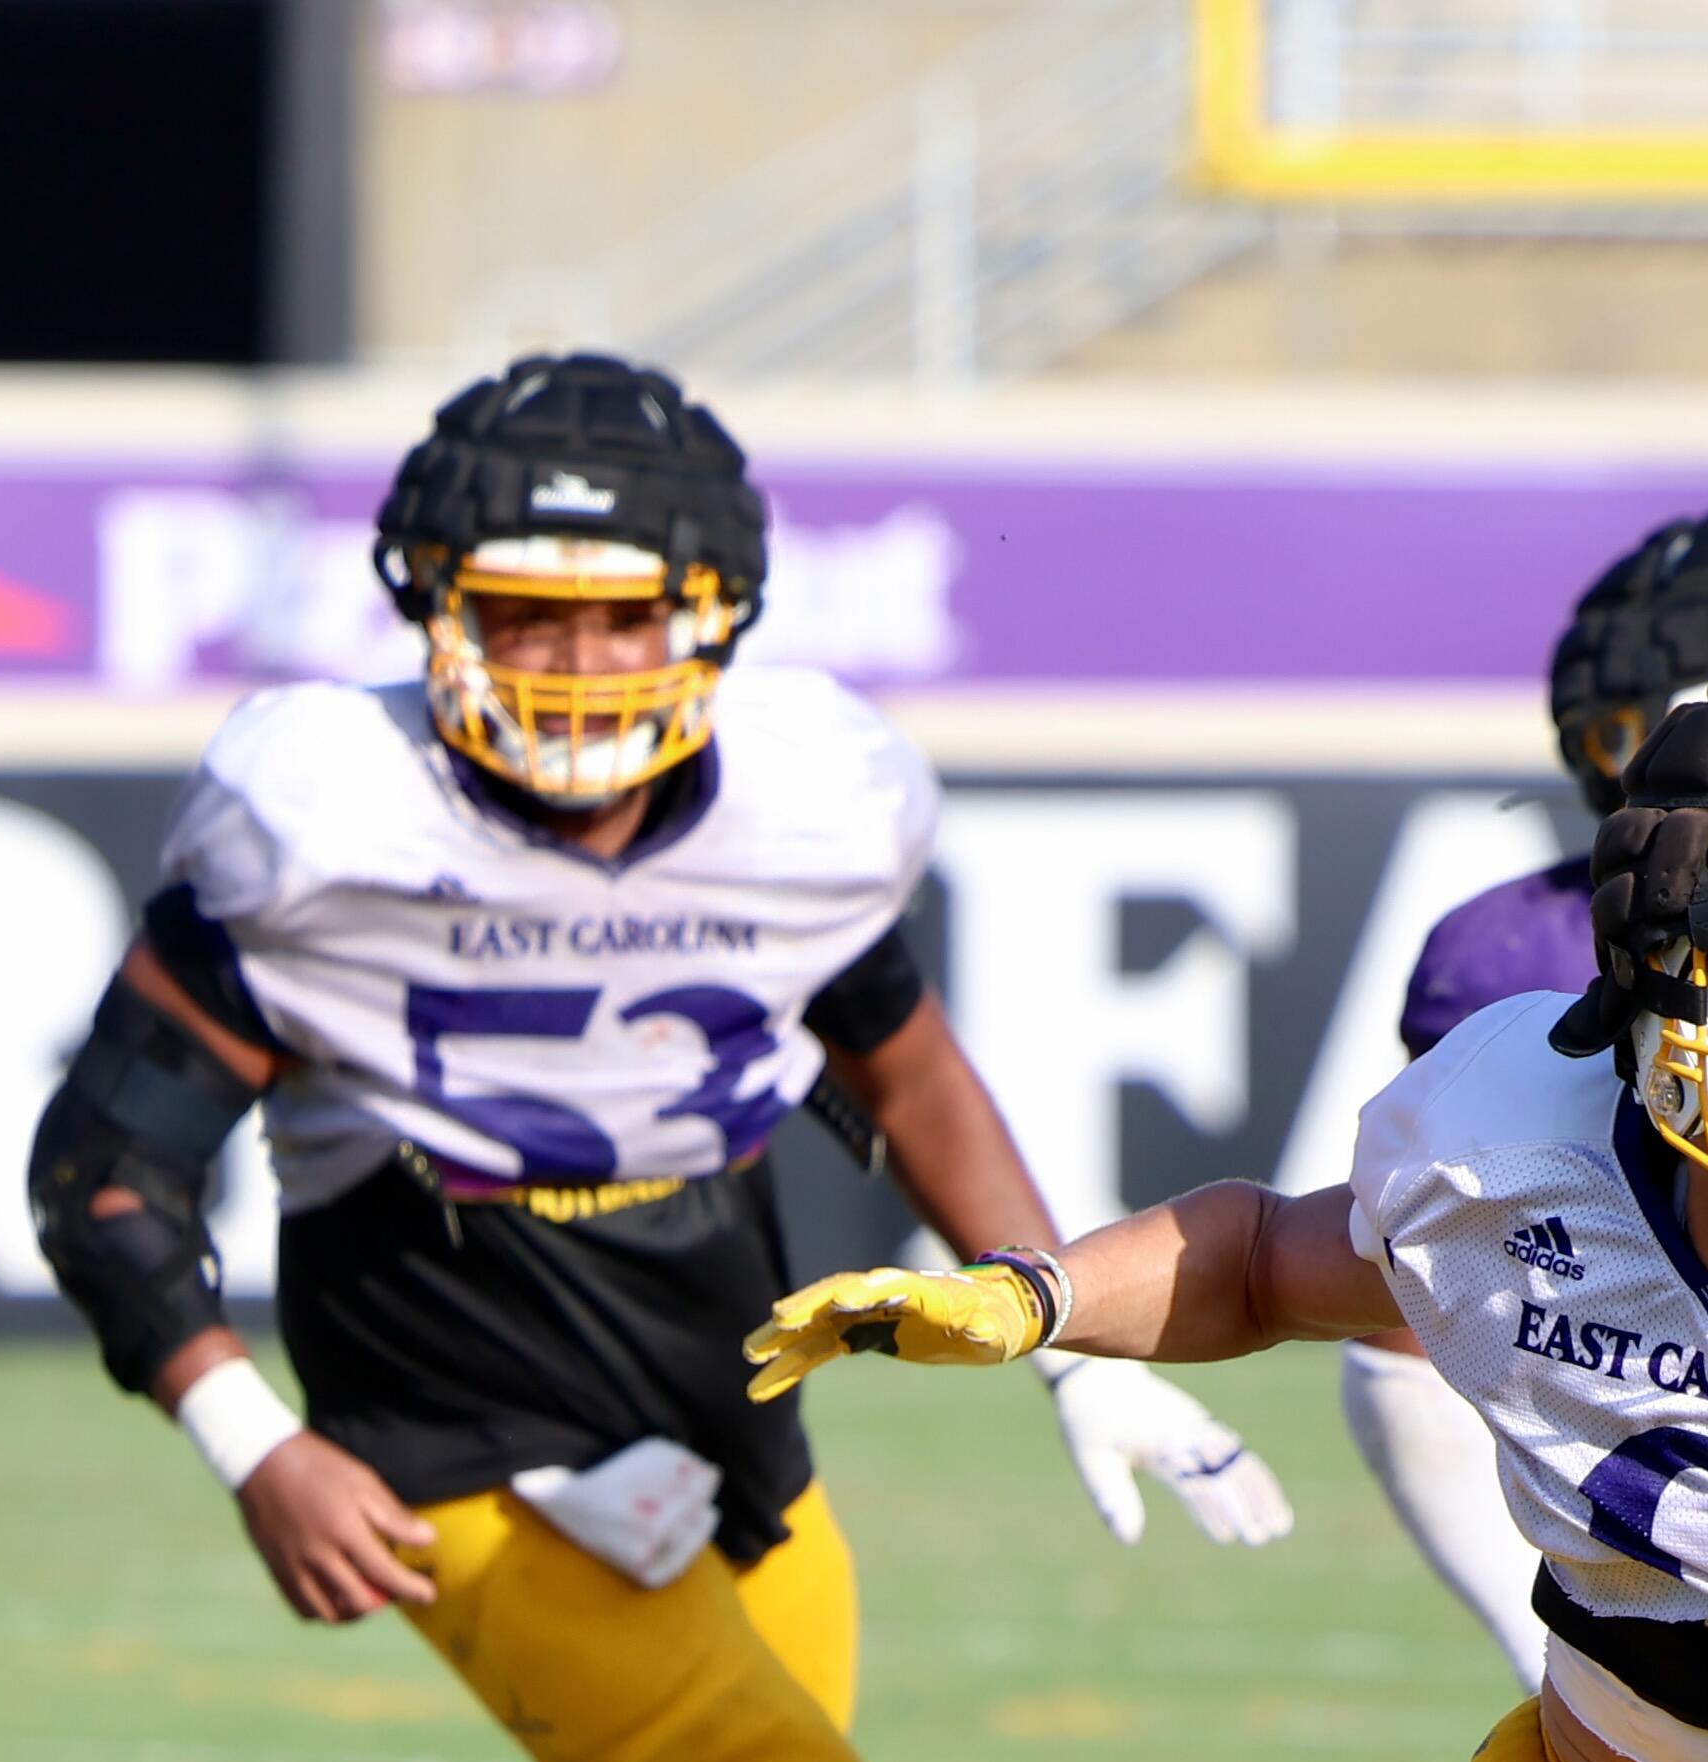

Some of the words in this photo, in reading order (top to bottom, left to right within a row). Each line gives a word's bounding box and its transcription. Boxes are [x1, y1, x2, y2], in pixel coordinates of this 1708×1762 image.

[450, 918, 560, 958] EAST
[404, 982, 791, 1183] 53
[1504, 1239, 1586, 1283] adidas
[1513, 1300, 1644, 1372] EAST
